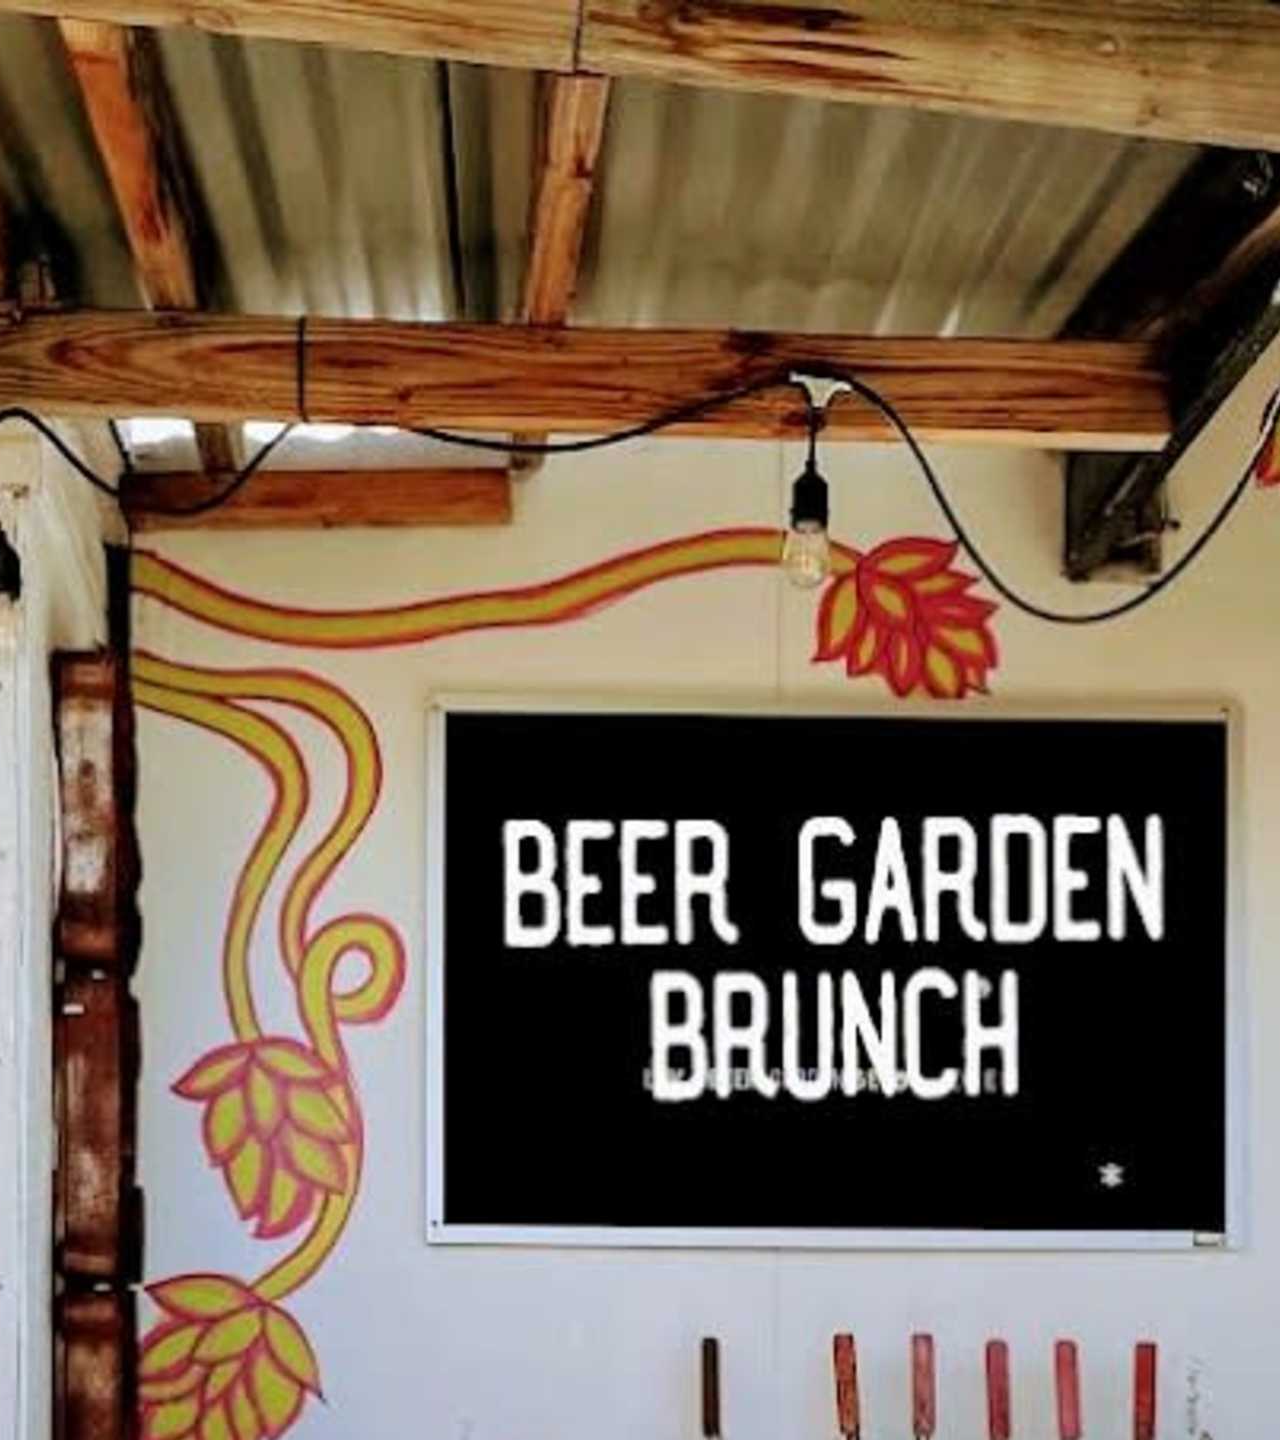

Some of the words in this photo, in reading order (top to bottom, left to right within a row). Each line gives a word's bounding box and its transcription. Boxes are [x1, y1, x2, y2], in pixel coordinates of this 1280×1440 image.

[501, 818, 740, 948] BEER
[797, 813, 1164, 946] GARDEN
[650, 967, 1020, 1102] BRUNCH
